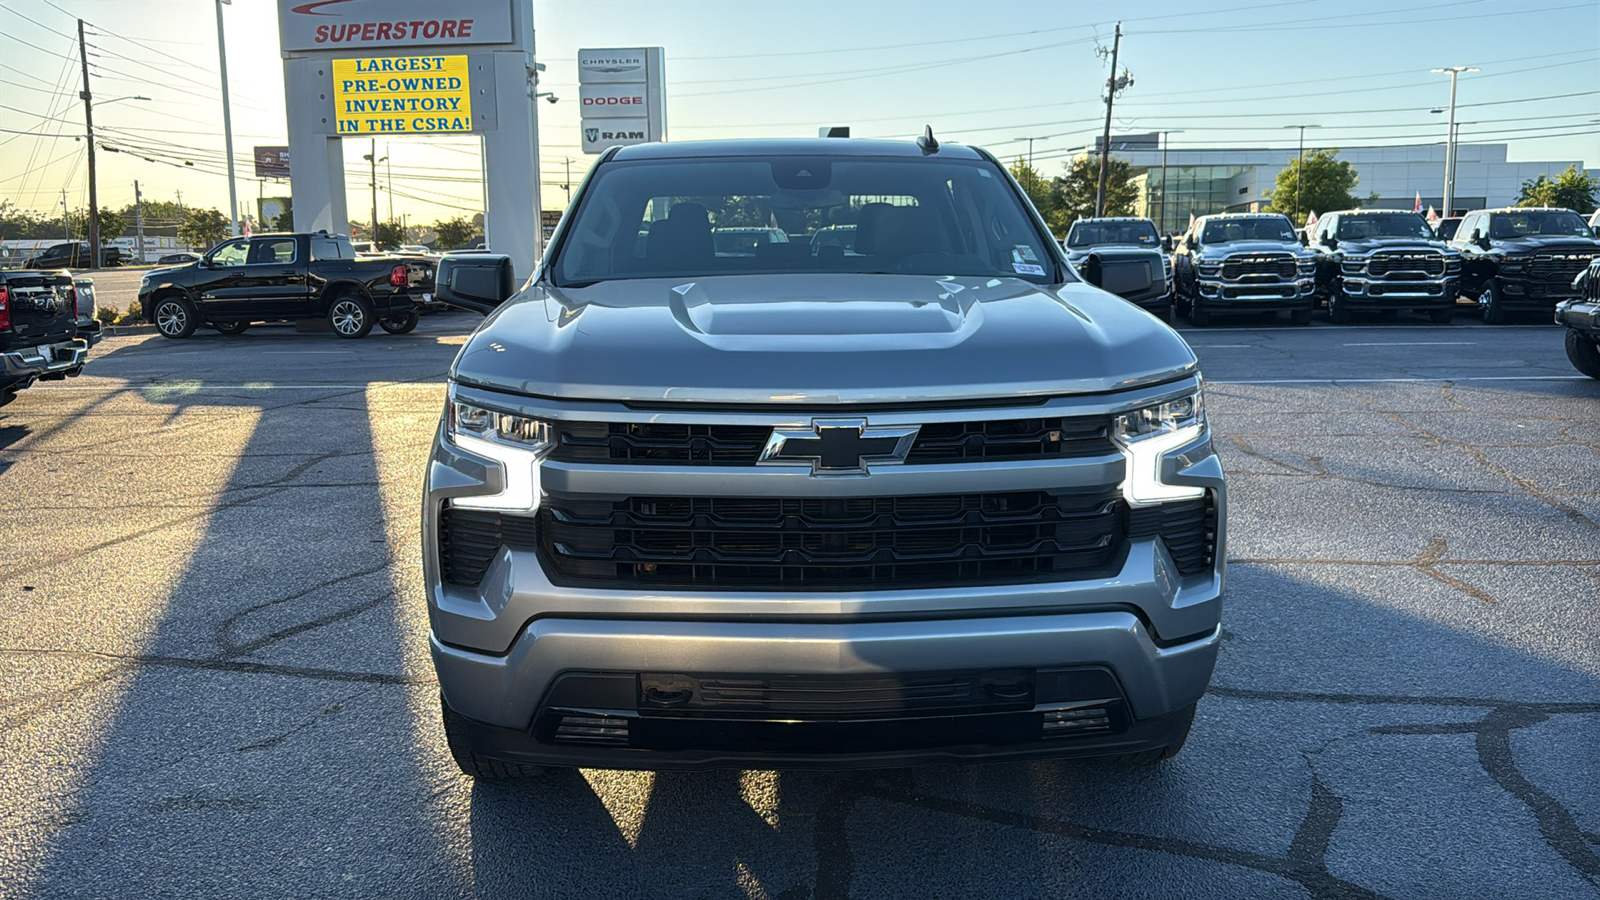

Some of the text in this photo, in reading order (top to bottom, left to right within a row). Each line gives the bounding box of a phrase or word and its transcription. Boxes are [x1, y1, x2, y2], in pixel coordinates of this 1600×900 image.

[314, 19, 474, 43] SUPERSTORE
[356, 57, 446, 72] LARGEST
[342, 77, 462, 92] PRE-OWNED
[345, 97, 462, 112] INVENTORY
[583, 96, 643, 106] DODGE
[339, 117, 471, 132] IN THE CSRA!
[602, 131, 644, 140] RAM
